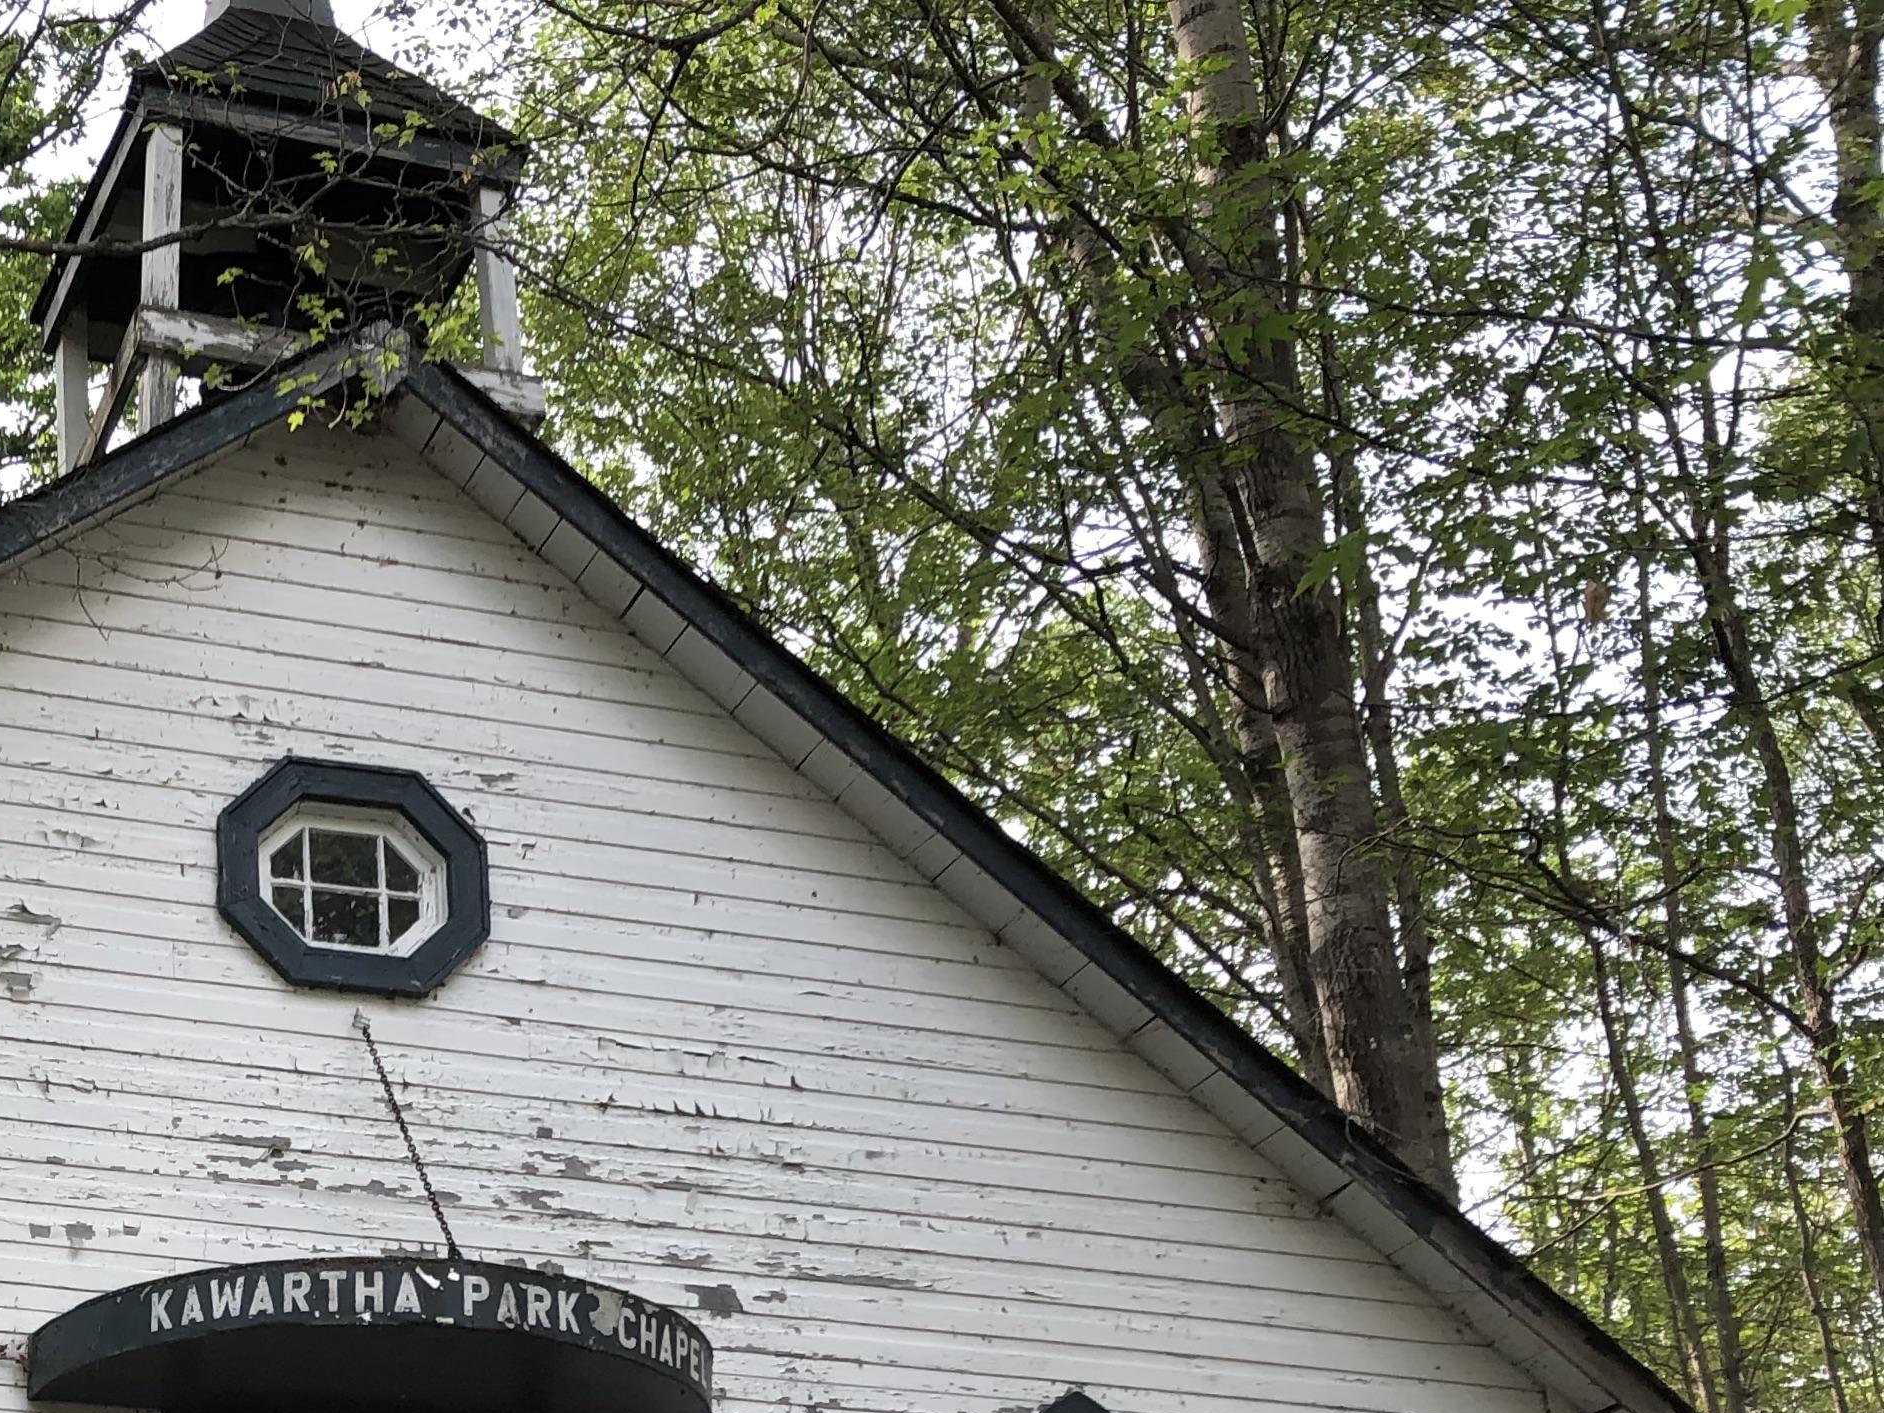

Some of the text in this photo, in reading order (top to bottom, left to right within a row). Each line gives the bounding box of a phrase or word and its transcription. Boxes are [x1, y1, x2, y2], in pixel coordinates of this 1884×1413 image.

[150, 1271, 708, 1388] KAWARTHA PARK CHAPEL
